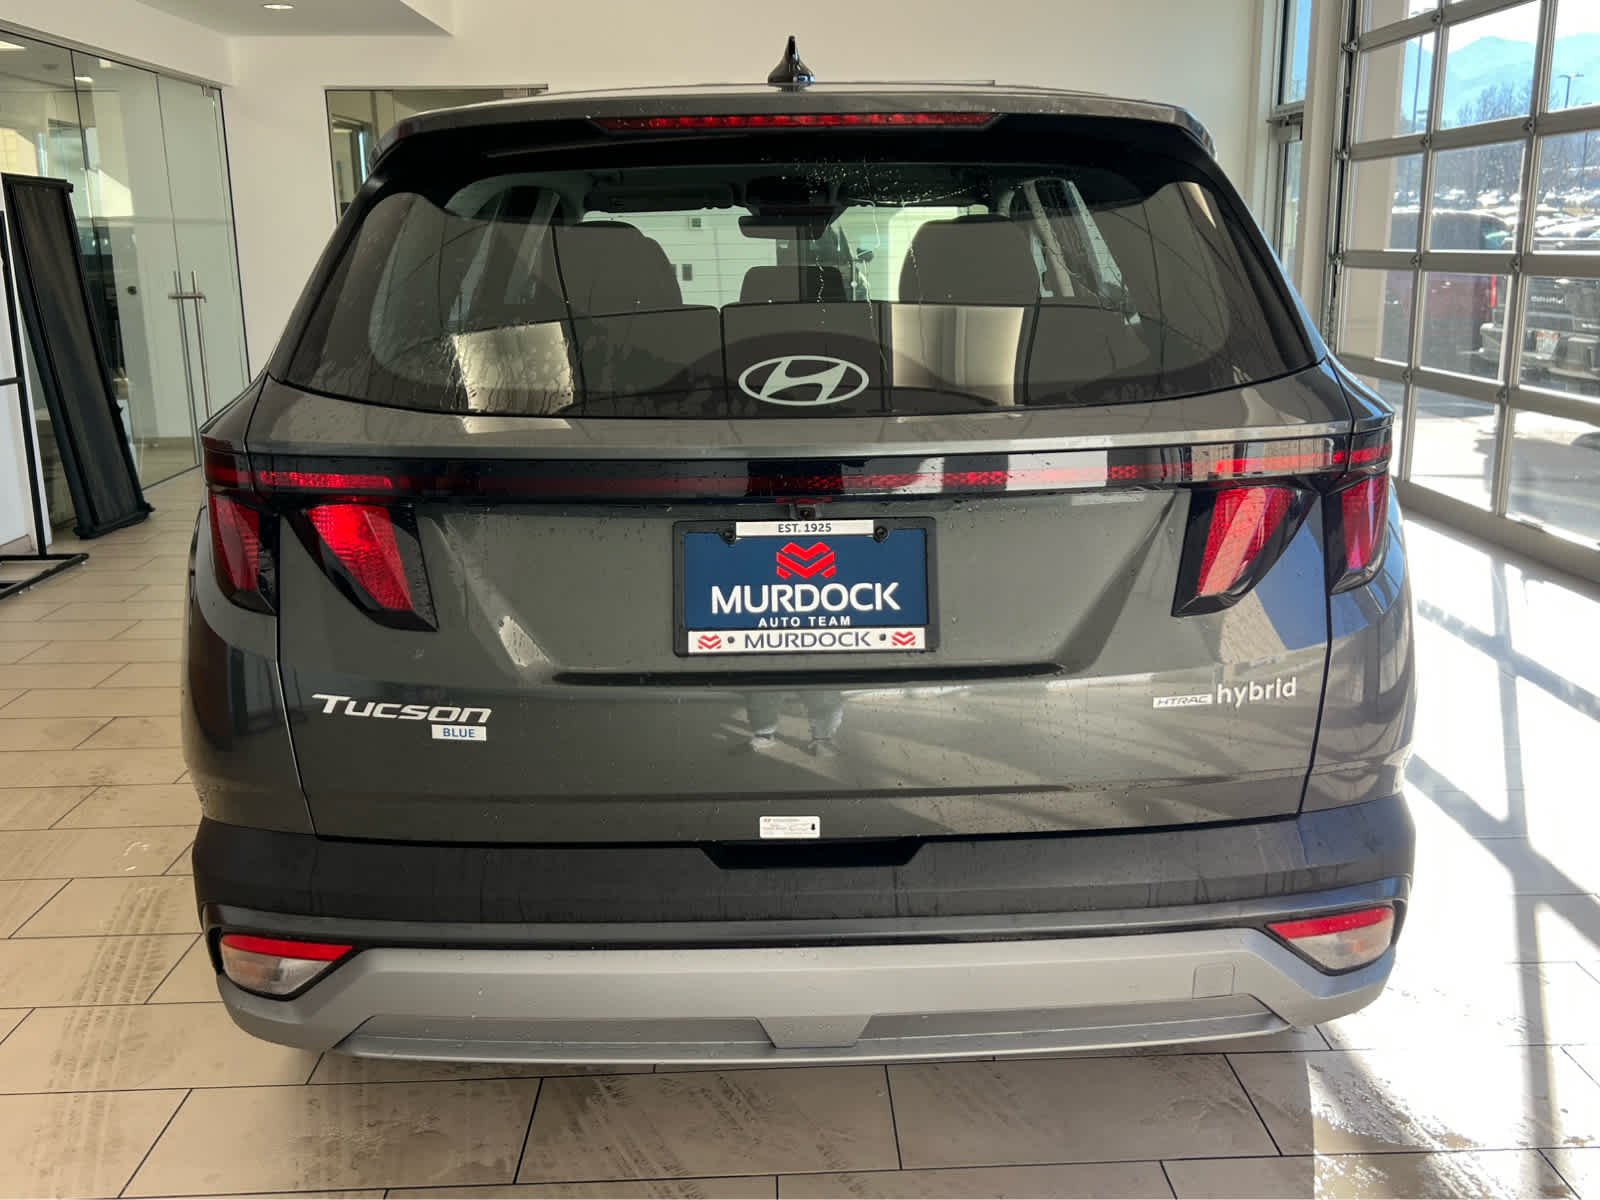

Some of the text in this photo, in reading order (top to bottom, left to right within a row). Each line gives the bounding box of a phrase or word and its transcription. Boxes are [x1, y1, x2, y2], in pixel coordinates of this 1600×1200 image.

[777, 522, 832, 533] EST. 1925
[711, 582, 901, 614] MURDOCK
[758, 615, 851, 628] AUTO TEAM
[744, 631, 872, 650] MURDOCK
[1156, 676, 1297, 709] HTRAC hybrid
[442, 727, 476, 738] BLUE
